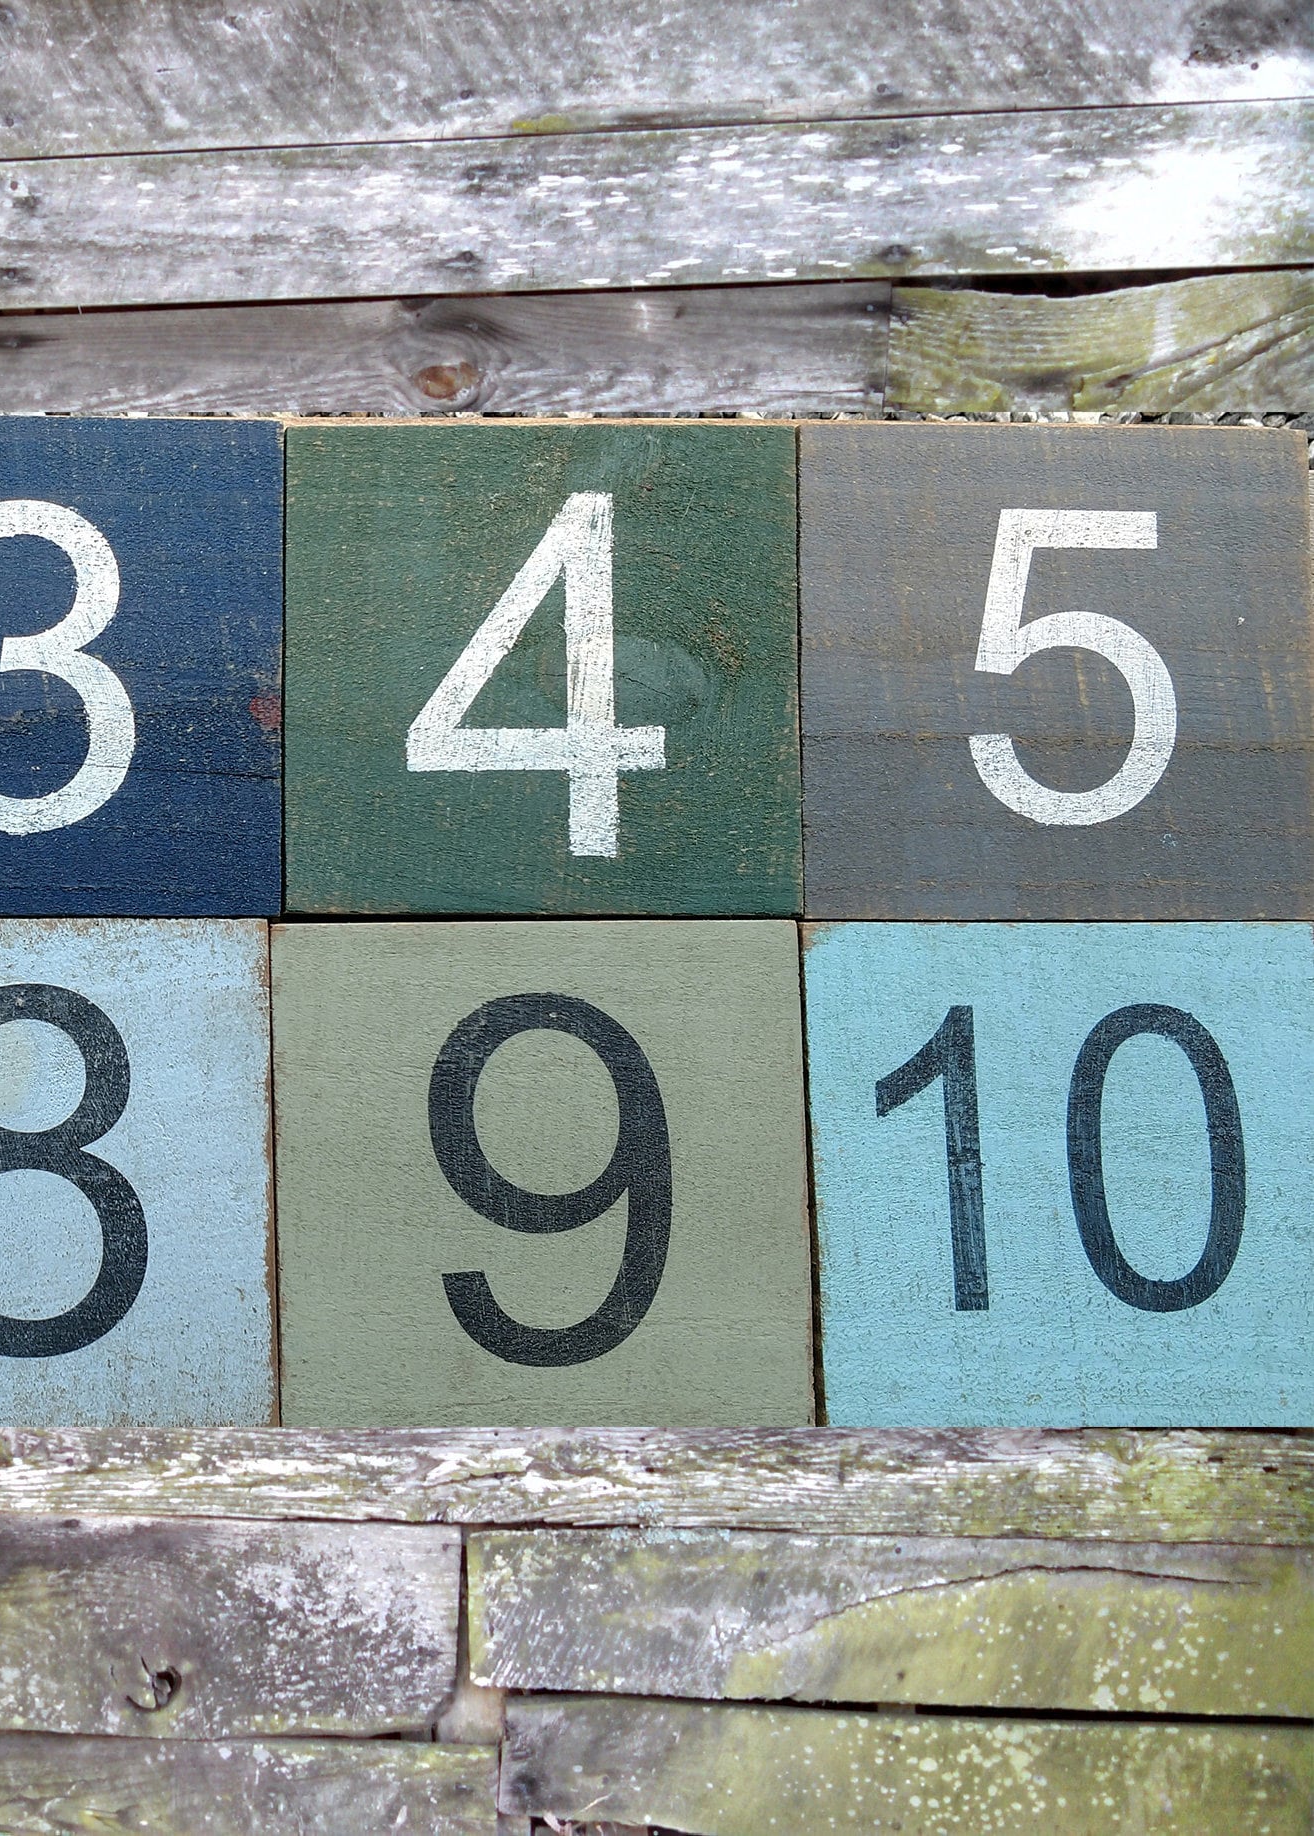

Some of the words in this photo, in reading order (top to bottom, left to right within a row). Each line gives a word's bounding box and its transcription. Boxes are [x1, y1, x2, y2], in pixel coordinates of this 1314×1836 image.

[406, 491, 666, 857] 4
[970, 509, 1176, 826] 5
[428, 993, 673, 1367] 9
[876, 1004, 1246, 1313] 10
